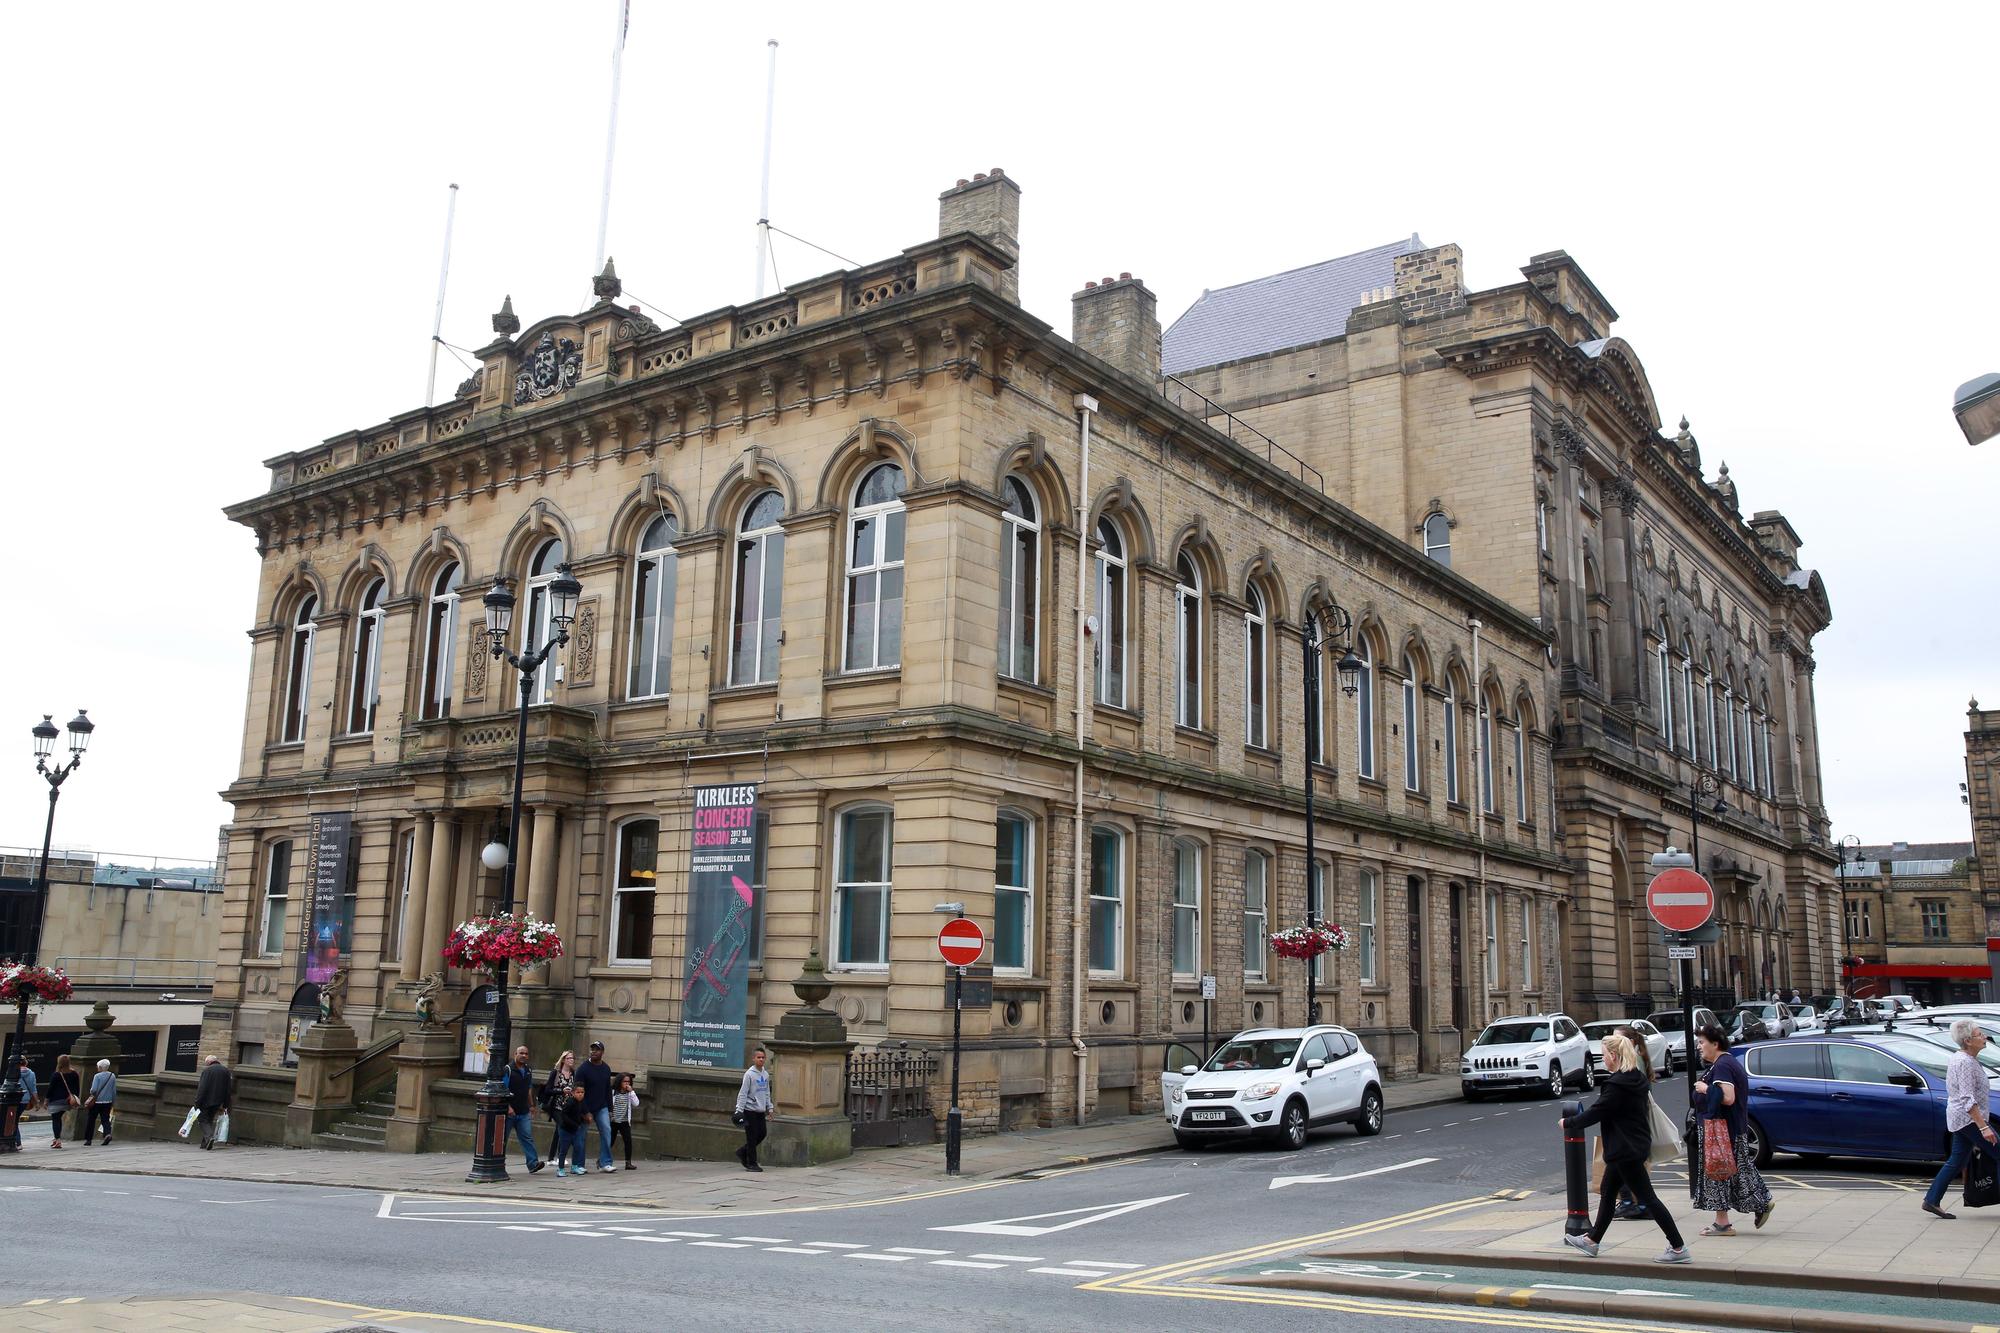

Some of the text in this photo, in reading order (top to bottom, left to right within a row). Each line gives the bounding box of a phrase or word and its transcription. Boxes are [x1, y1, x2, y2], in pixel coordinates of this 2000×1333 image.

[696, 786, 754, 807] KIRKLEES
[695, 807, 753, 829] CONCERT
[694, 831, 730, 846] SEASON
[693, 855, 751, 863] KIRKLEESTOWNHALLS.CO.UK
[692, 865, 734, 873] OPERANORTH.CO.UK
[301, 817, 321, 954] Huddersfield Town Hall
[683, 1039, 709, 1048] Family-friendly
[1975, 1176, 1992, 1188] M&S
